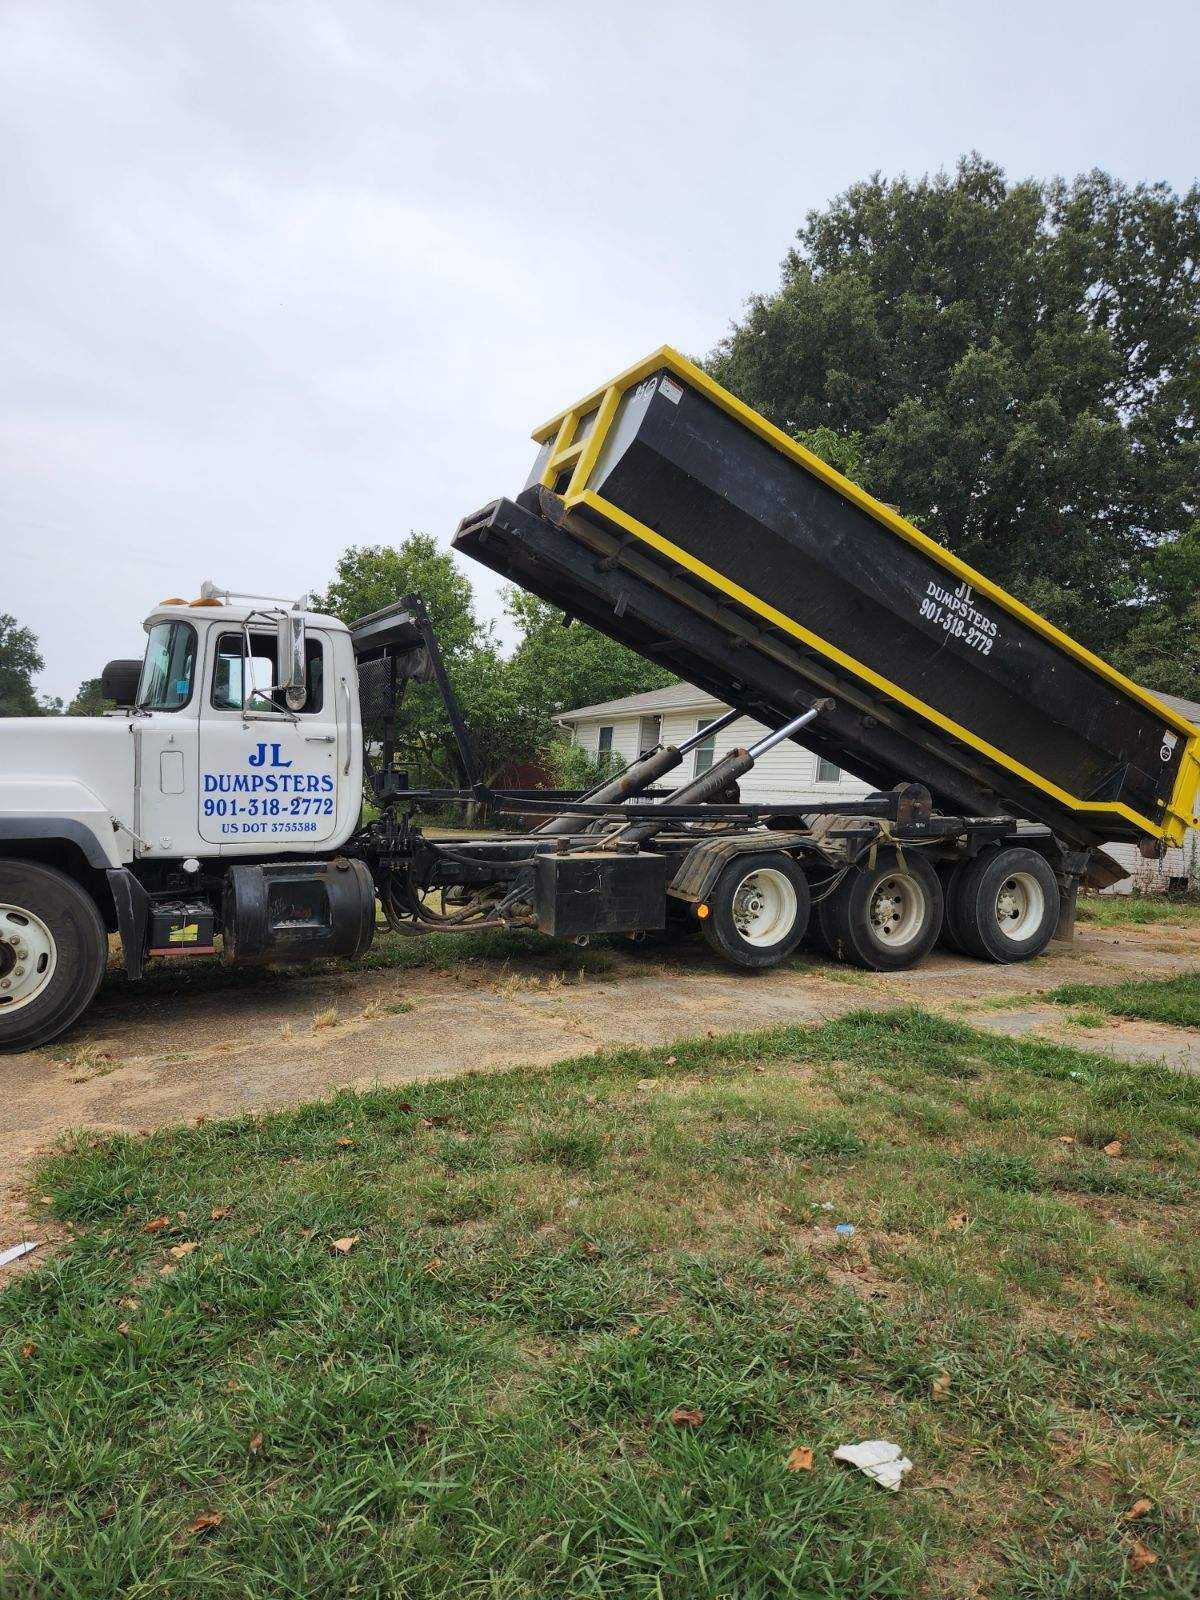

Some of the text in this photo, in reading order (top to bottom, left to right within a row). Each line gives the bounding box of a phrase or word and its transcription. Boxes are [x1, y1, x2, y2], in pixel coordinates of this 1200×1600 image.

[955, 582, 974, 606] JL
[926, 581, 997, 637] DUMPSTERS
[919, 598, 993, 656] 901-318-2772
[248, 743, 293, 768] JL
[204, 774, 334, 793] DUMPSTERS
[204, 798, 334, 816] 901-318-2772
[222, 822, 317, 833] US DOT 3755388
